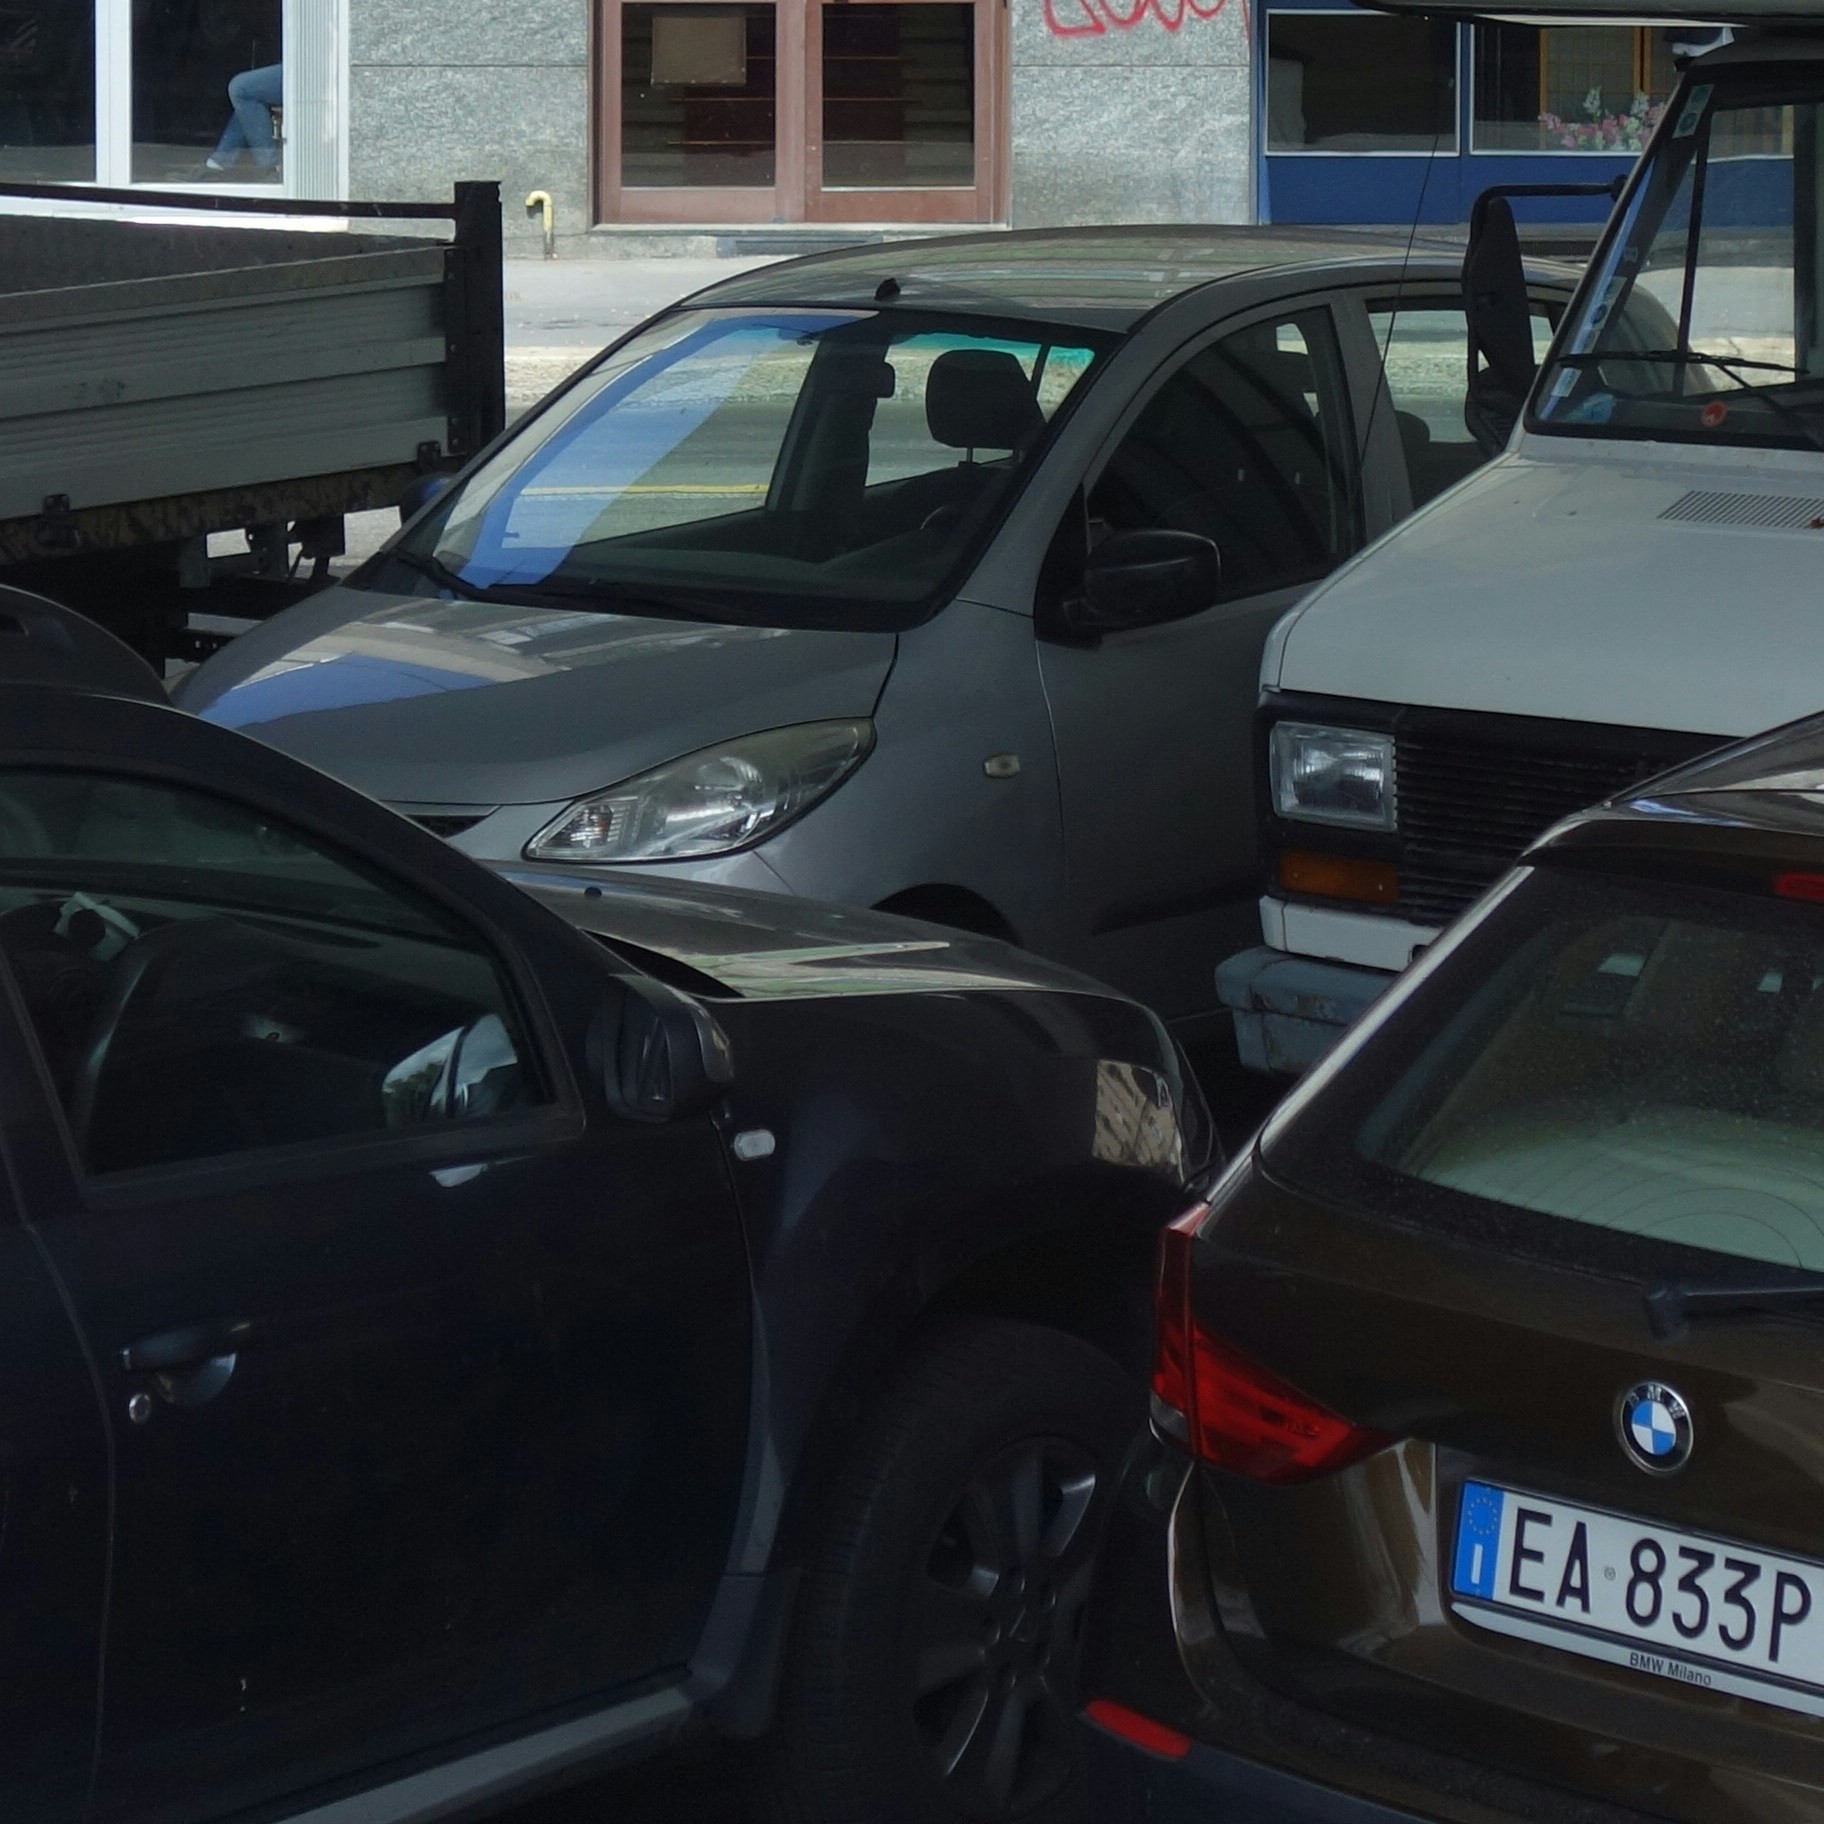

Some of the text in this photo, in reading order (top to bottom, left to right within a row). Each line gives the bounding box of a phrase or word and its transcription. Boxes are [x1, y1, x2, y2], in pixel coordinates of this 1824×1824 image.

[1508, 1506, 1591, 1614] EA
[1628, 1651, 1713, 1687] BMW Milano
